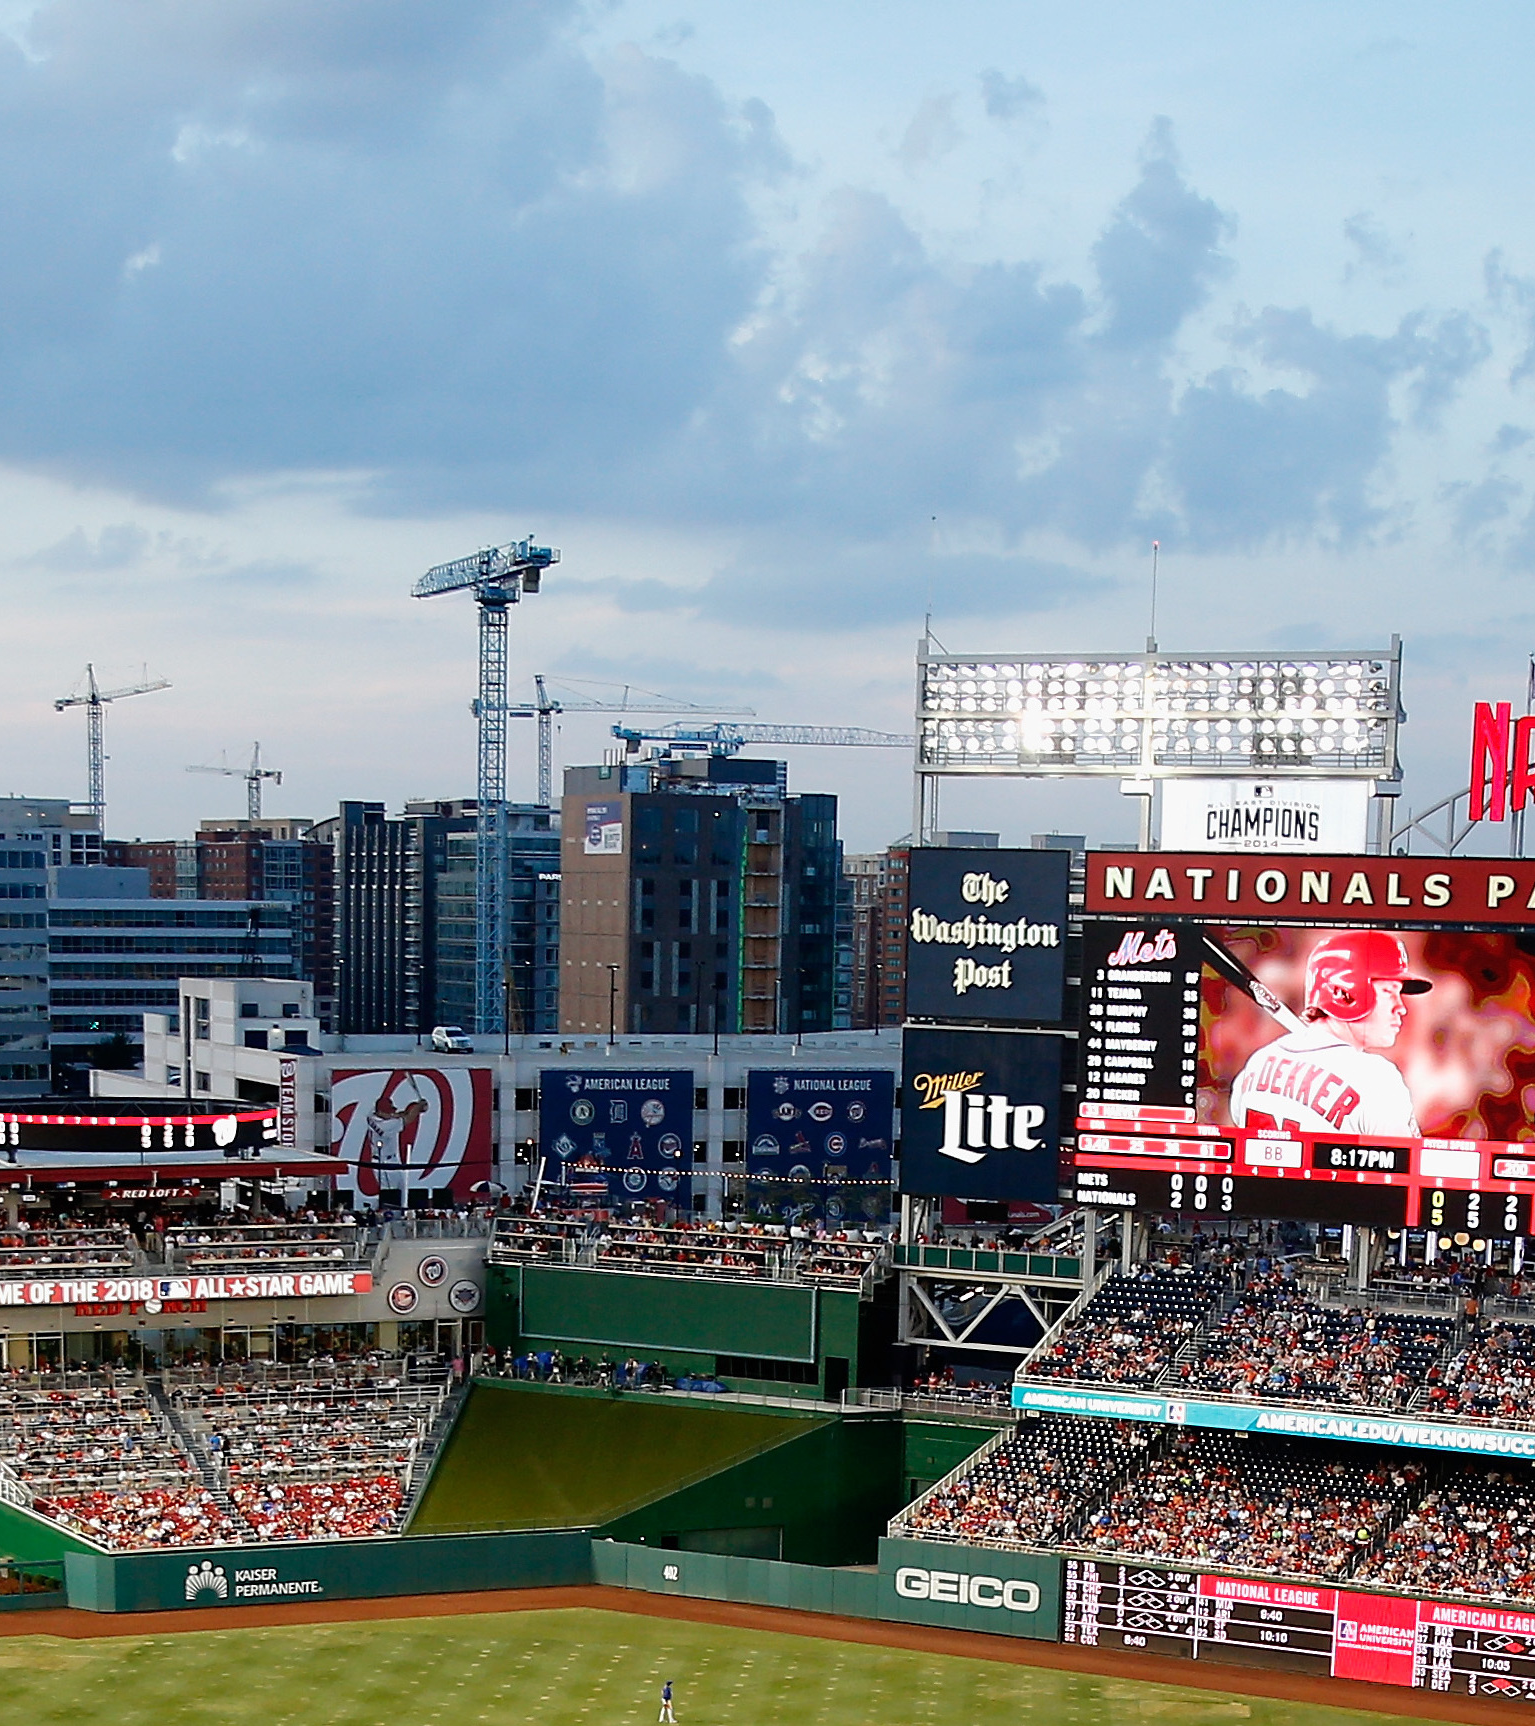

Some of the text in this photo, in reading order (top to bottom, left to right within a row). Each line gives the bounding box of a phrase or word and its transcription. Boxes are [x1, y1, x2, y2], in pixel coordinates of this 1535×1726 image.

[1207, 808, 1319, 841] CHAMPIONS
[1244, 840, 1278, 848] 2014
[962, 873, 1009, 906] The
[1105, 866, 1451, 907] NATIONALS
[910, 909, 1059, 953] Washington
[1108, 929, 1176, 966] Mets
[953, 958, 1013, 994] Post
[281, 1083, 295, 1113] TEAM
[584, 1078, 670, 1090] AMERICAN LEAGUE
[794, 1079, 871, 1091] NATIONAL LEAGUE
[913, 1070, 984, 1108] Miller
[1256, 1056, 1360, 1130] DEKKER
[939, 1093, 1048, 1163] Lite
[1331, 1148, 1394, 1168] 8:17PM
[122, 1188, 179, 1199] RED LOFT
[1078, 1173, 1517, 1212] METS 0 0 0 0 2 2
[1078, 1191, 1517, 1231] NATIONALS 2 0 3 5 5 0
[31, 1282, 55, 1303] OF
[60, 1281, 98, 1302] THE
[104, 1281, 153, 1301] 2018
[300, 1274, 355, 1295] GAME
[1022, 1392, 1161, 1418] AMERICAN UNIVERSITY
[235, 1568, 277, 1583] KAISER
[895, 1567, 1039, 1613] GEICO
[1216, 1581, 1319, 1606] NATIONAL LEAGUE
[1360, 1624, 1414, 1638] AMERICAN
[1433, 1606, 1496, 1627] AMERICAN
[1360, 1634, 1414, 1648] UNIVERSITY
[1482, 1658, 1510, 1671] 10:05
